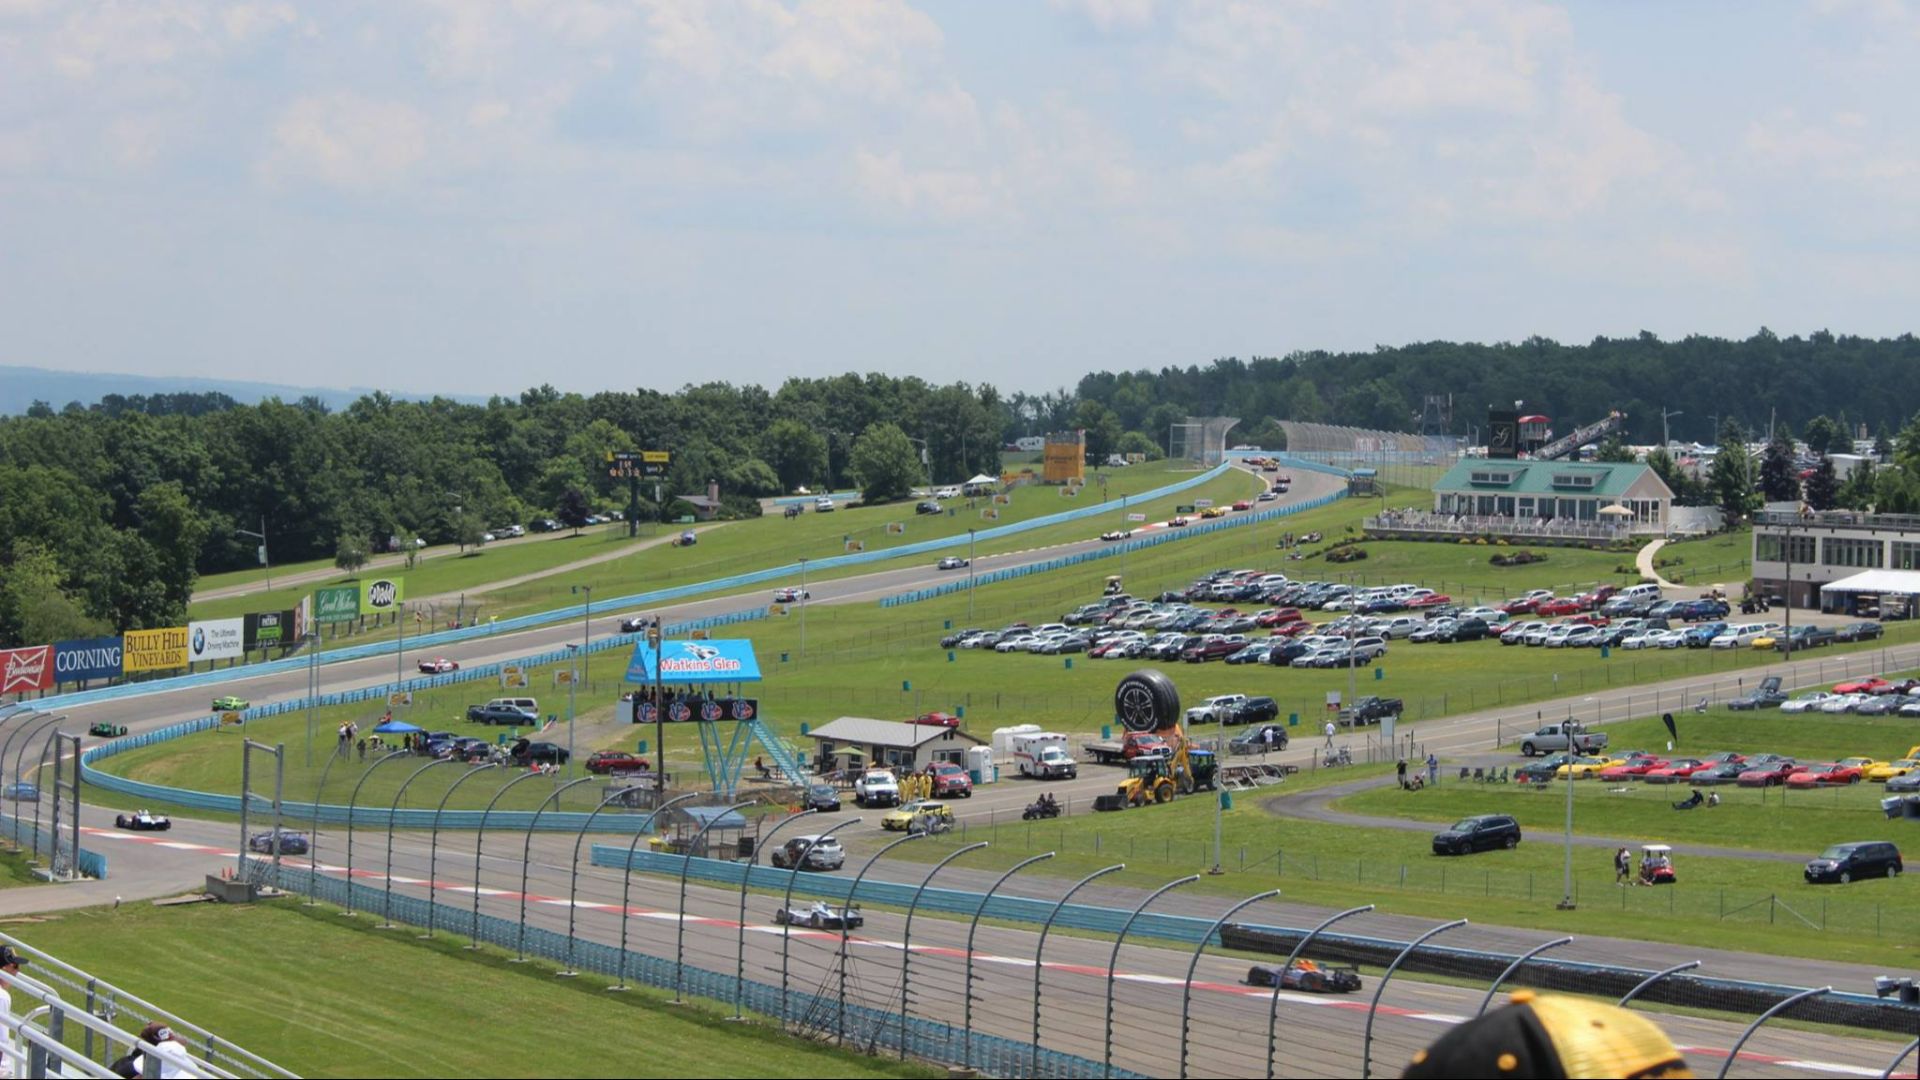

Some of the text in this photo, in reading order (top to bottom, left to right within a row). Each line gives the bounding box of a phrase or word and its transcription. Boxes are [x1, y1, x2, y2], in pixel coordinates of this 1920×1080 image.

[126, 631, 187, 654] BULLY HILL
[57, 647, 121, 672] CORNING
[132, 650, 182, 668] VINEYARDS
[660, 658, 740, 671] Watkins Glen
